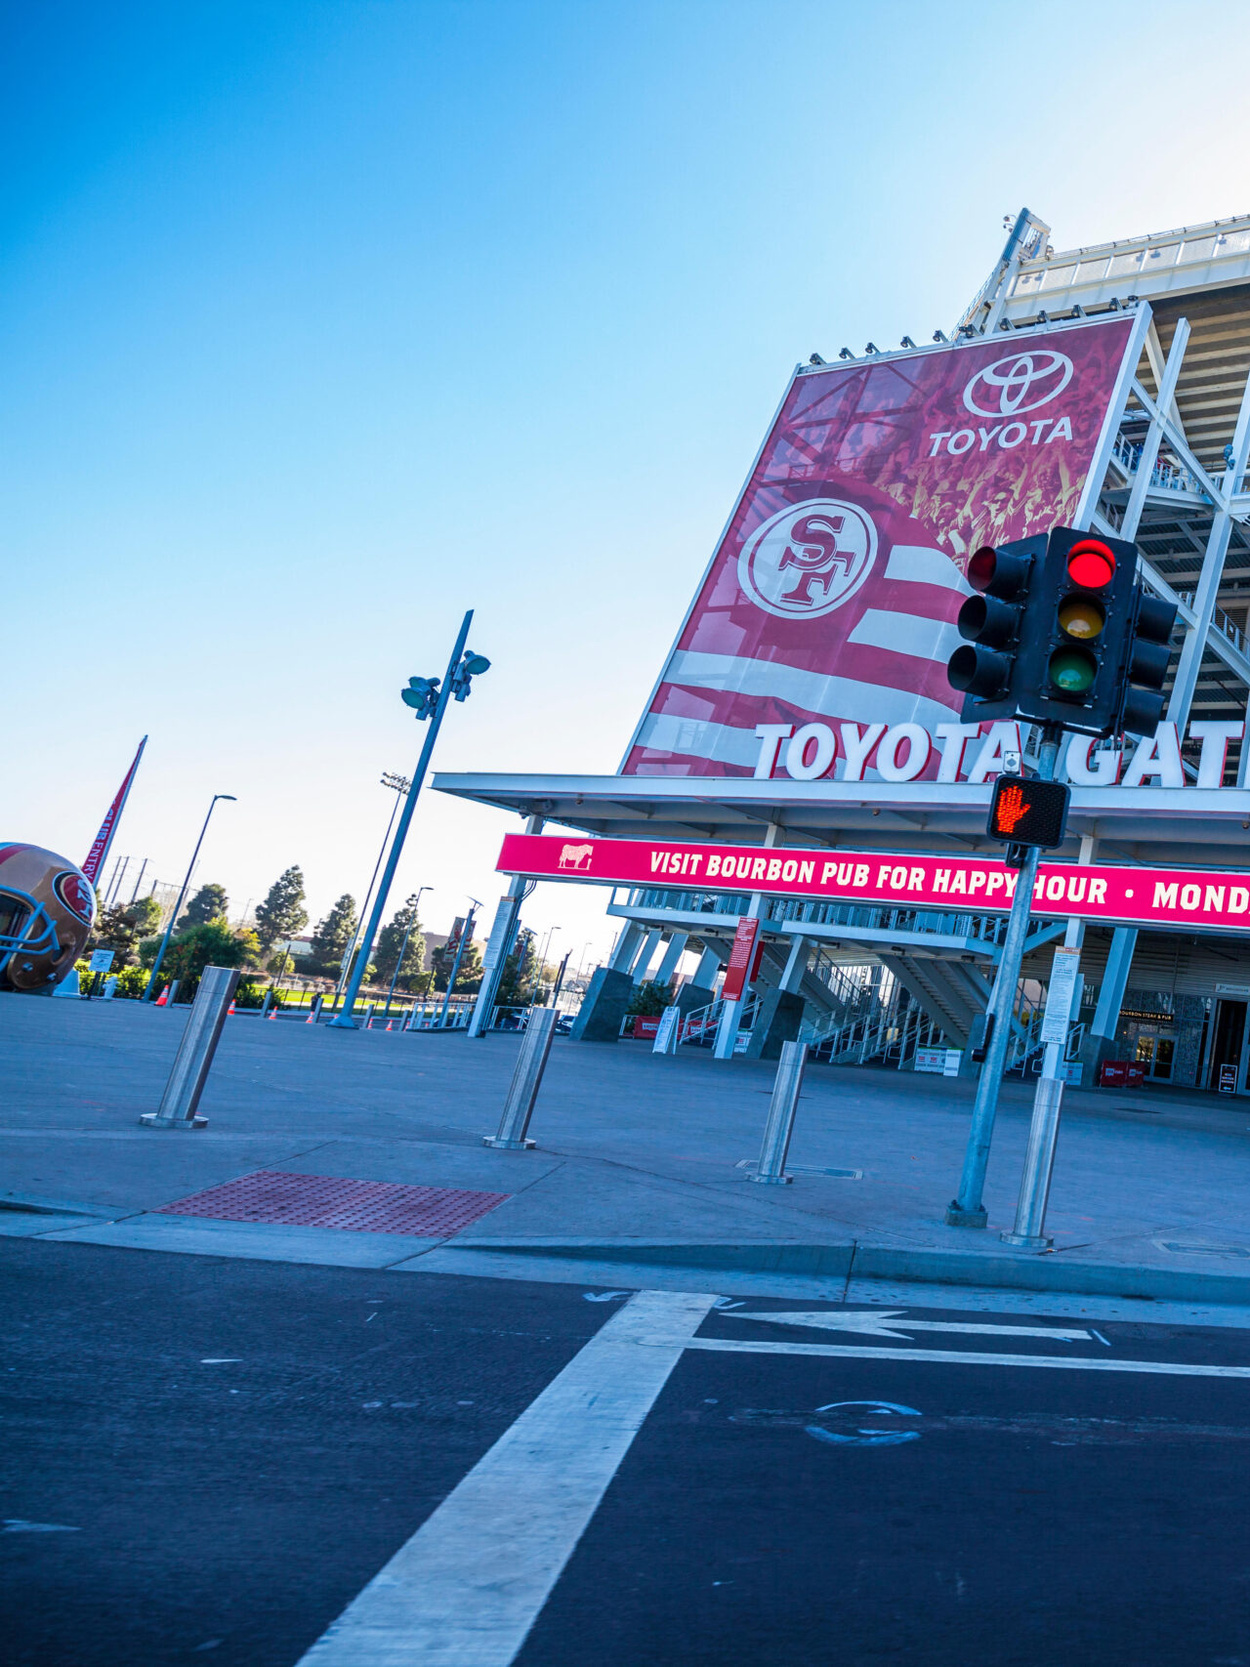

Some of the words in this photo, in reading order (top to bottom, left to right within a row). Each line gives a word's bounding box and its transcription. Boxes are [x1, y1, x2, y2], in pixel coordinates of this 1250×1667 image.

[929, 416, 1074, 457] TOYOTA
[753, 719, 1025, 783] TOYOTA
[84, 842, 104, 879] ENTRY
[650, 851, 703, 876] VISIT
[705, 855, 815, 883] BOURBON
[820, 862, 870, 887] PUB
[876, 865, 926, 891] FOR
[932, 868, 1019, 898] HAPPY
[1032, 874, 1108, 904] HOUR
